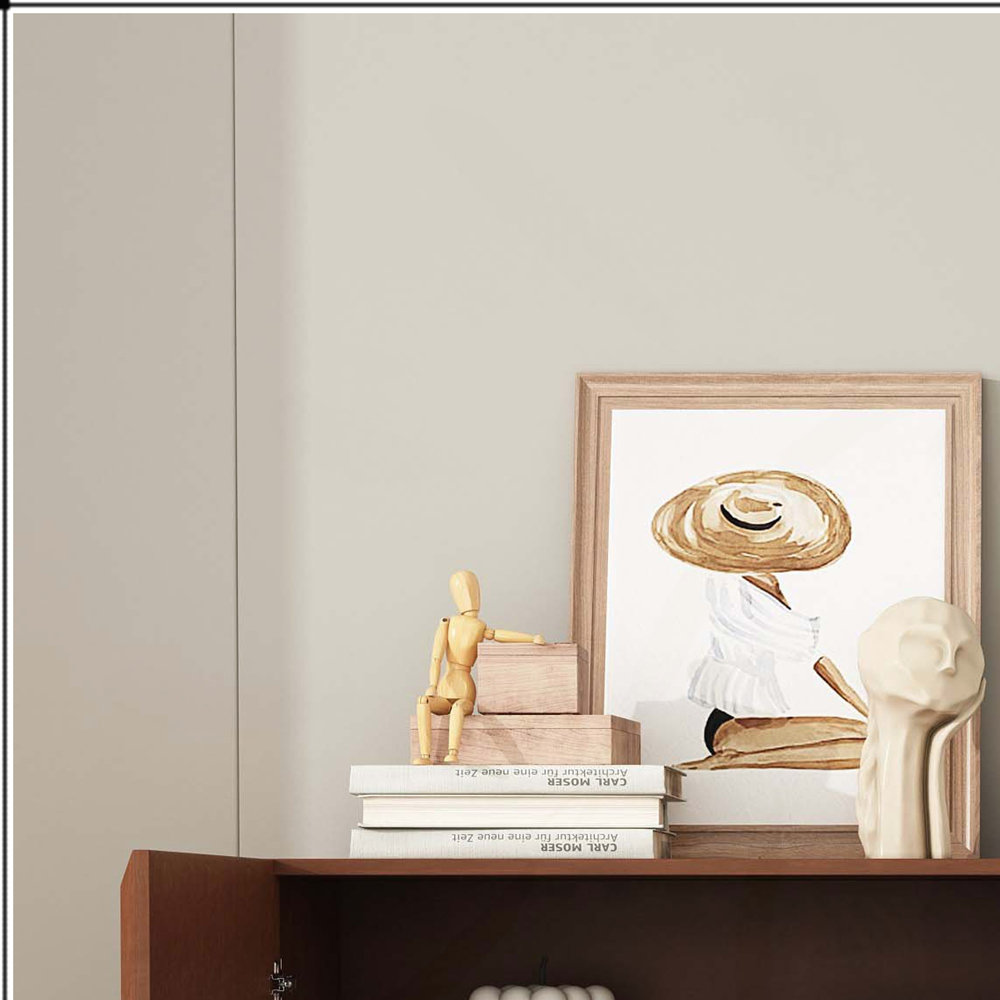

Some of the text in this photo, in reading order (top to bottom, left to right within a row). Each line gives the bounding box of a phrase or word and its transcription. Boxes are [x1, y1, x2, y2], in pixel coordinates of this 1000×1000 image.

[455, 768, 628, 778] Architektur für eine neue Zeit
[547, 778, 627, 787] CARL MOSER
[452, 833, 618, 843] Architektur für eine neue Zeit
[541, 843, 618, 852] CARL MOSER
